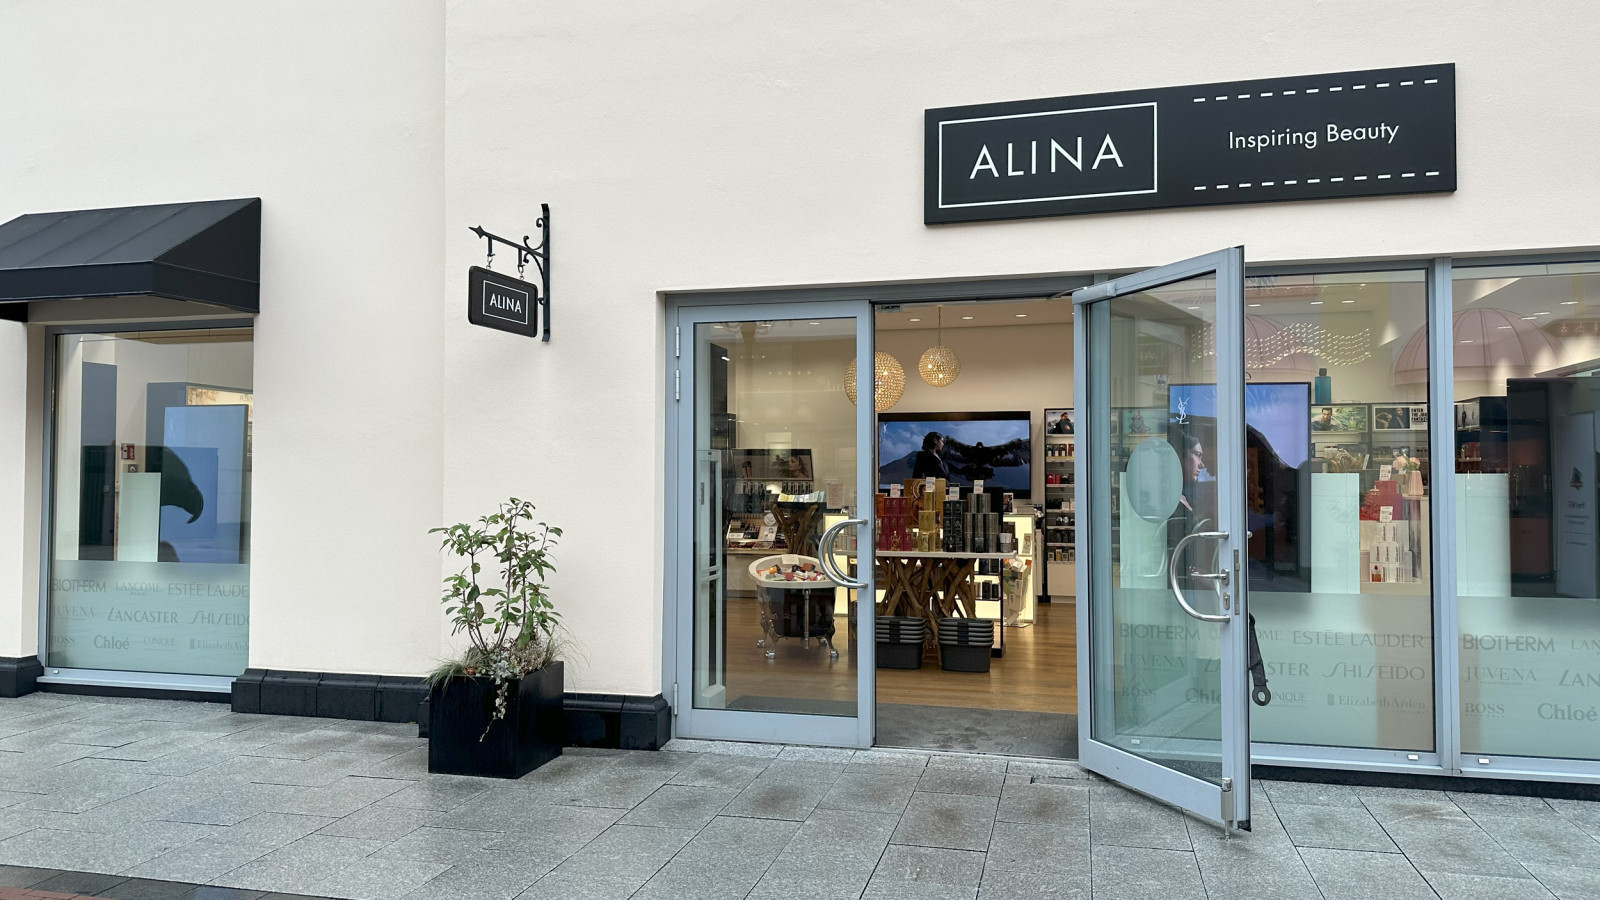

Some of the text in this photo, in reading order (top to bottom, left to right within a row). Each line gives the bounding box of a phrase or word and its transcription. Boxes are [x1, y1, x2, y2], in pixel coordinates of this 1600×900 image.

[1229, 123, 1399, 150] Inspiring Beauty
[970, 133, 1124, 180] ALINA
[489, 293, 522, 314] ALINA
[51, 578, 107, 593] BIOTHERM
[207, 585, 249, 599] LAUDE
[107, 607, 178, 624] LANCASTER
[187, 610, 249, 626] SHISEID
[1120, 623, 1200, 640] BIOTHERM
[1351, 632, 1424, 648] LAUDER
[94, 634, 129, 650] Chloé
[1463, 633, 1555, 652] BIOTHERM
[1123, 654, 1186, 669] JUVENA
[1321, 661, 1425, 680] SHISEIDO
[1464, 666, 1537, 683] JUVENA
[1558, 669, 1600, 687] LAN
[1272, 691, 1307, 703] INIQUE
[1464, 702, 1505, 715] BOSS
[1537, 702, 1598, 721] Chloé
